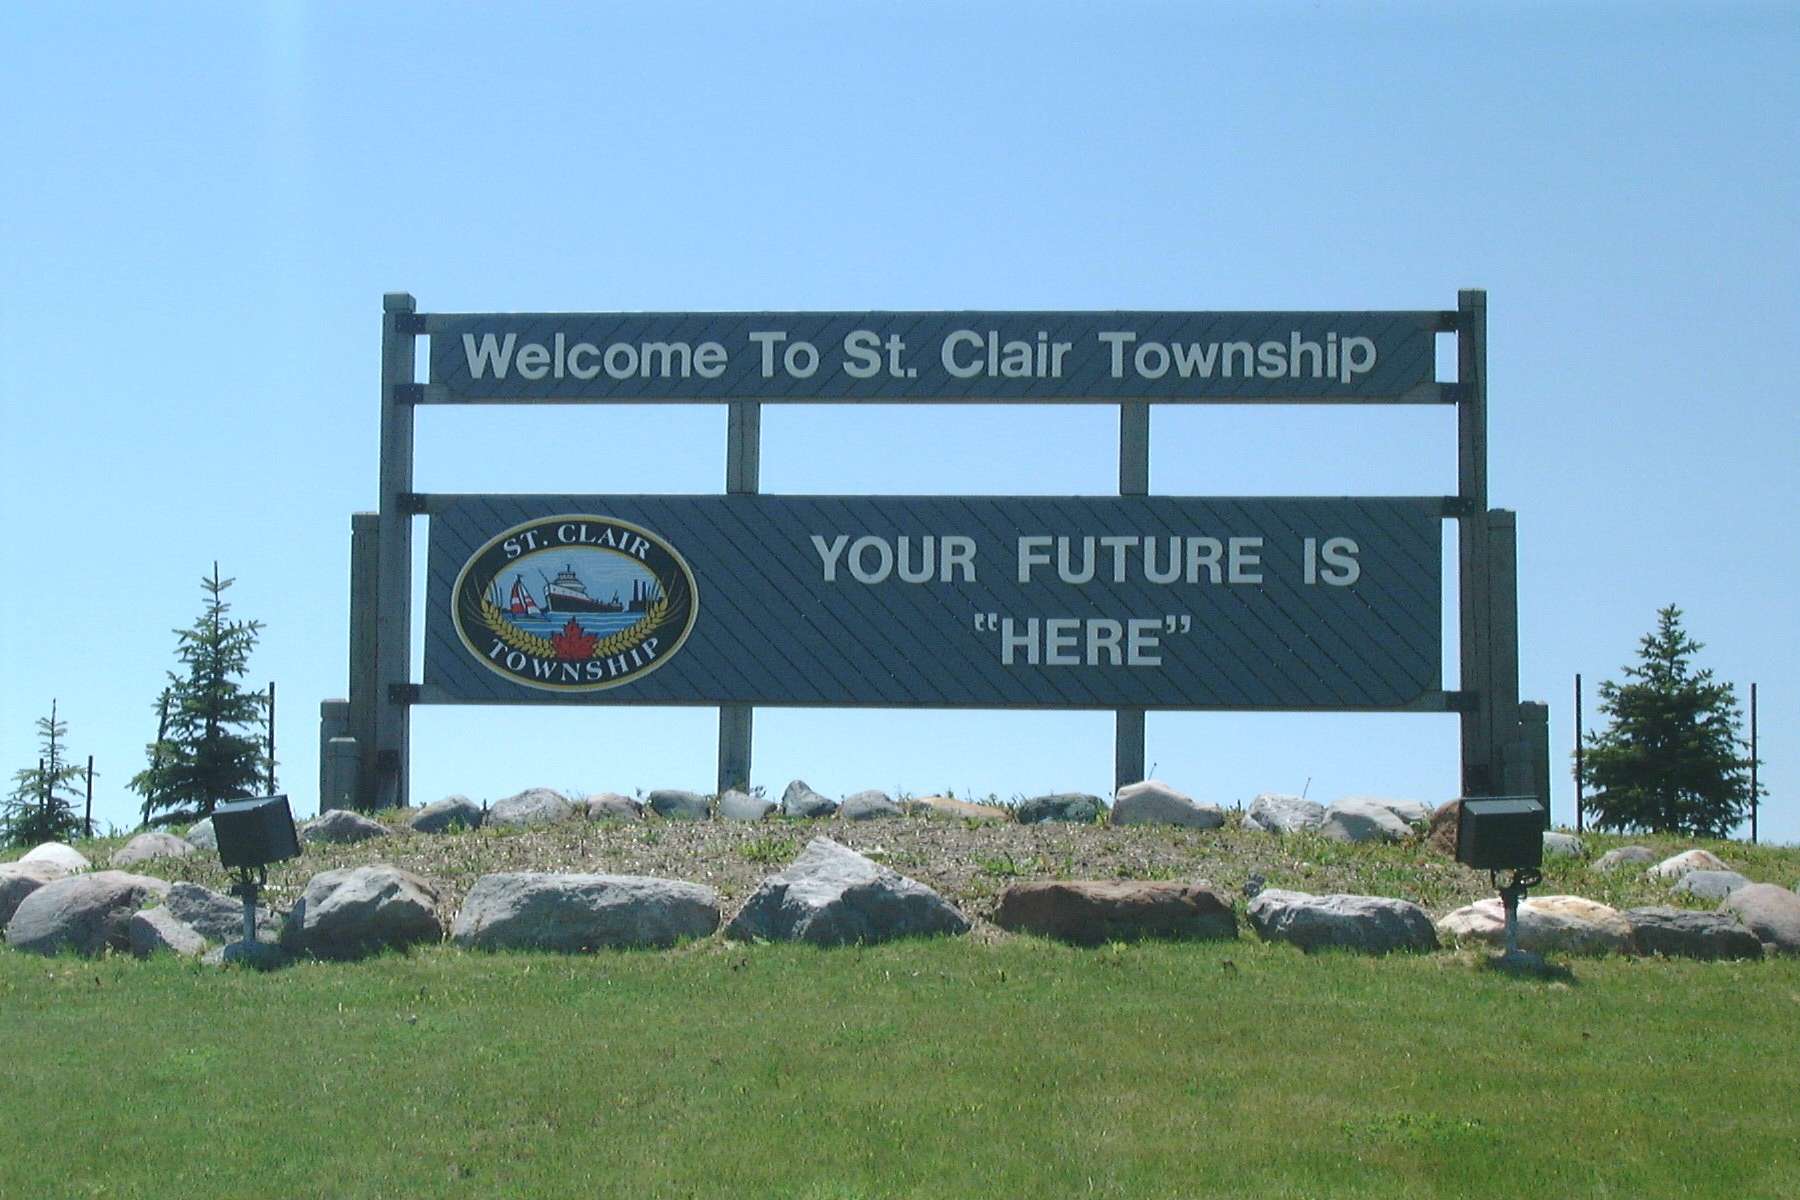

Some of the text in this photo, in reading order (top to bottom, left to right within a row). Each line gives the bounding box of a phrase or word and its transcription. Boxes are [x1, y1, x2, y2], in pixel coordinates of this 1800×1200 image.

[462, 329, 1376, 384] Welcome To St. Clair Township
[503, 523, 651, 560] ST. CLAIR
[811, 535, 1361, 586] YOUR FUTURE IS
[487, 637, 659, 682] TOWNSHIP
